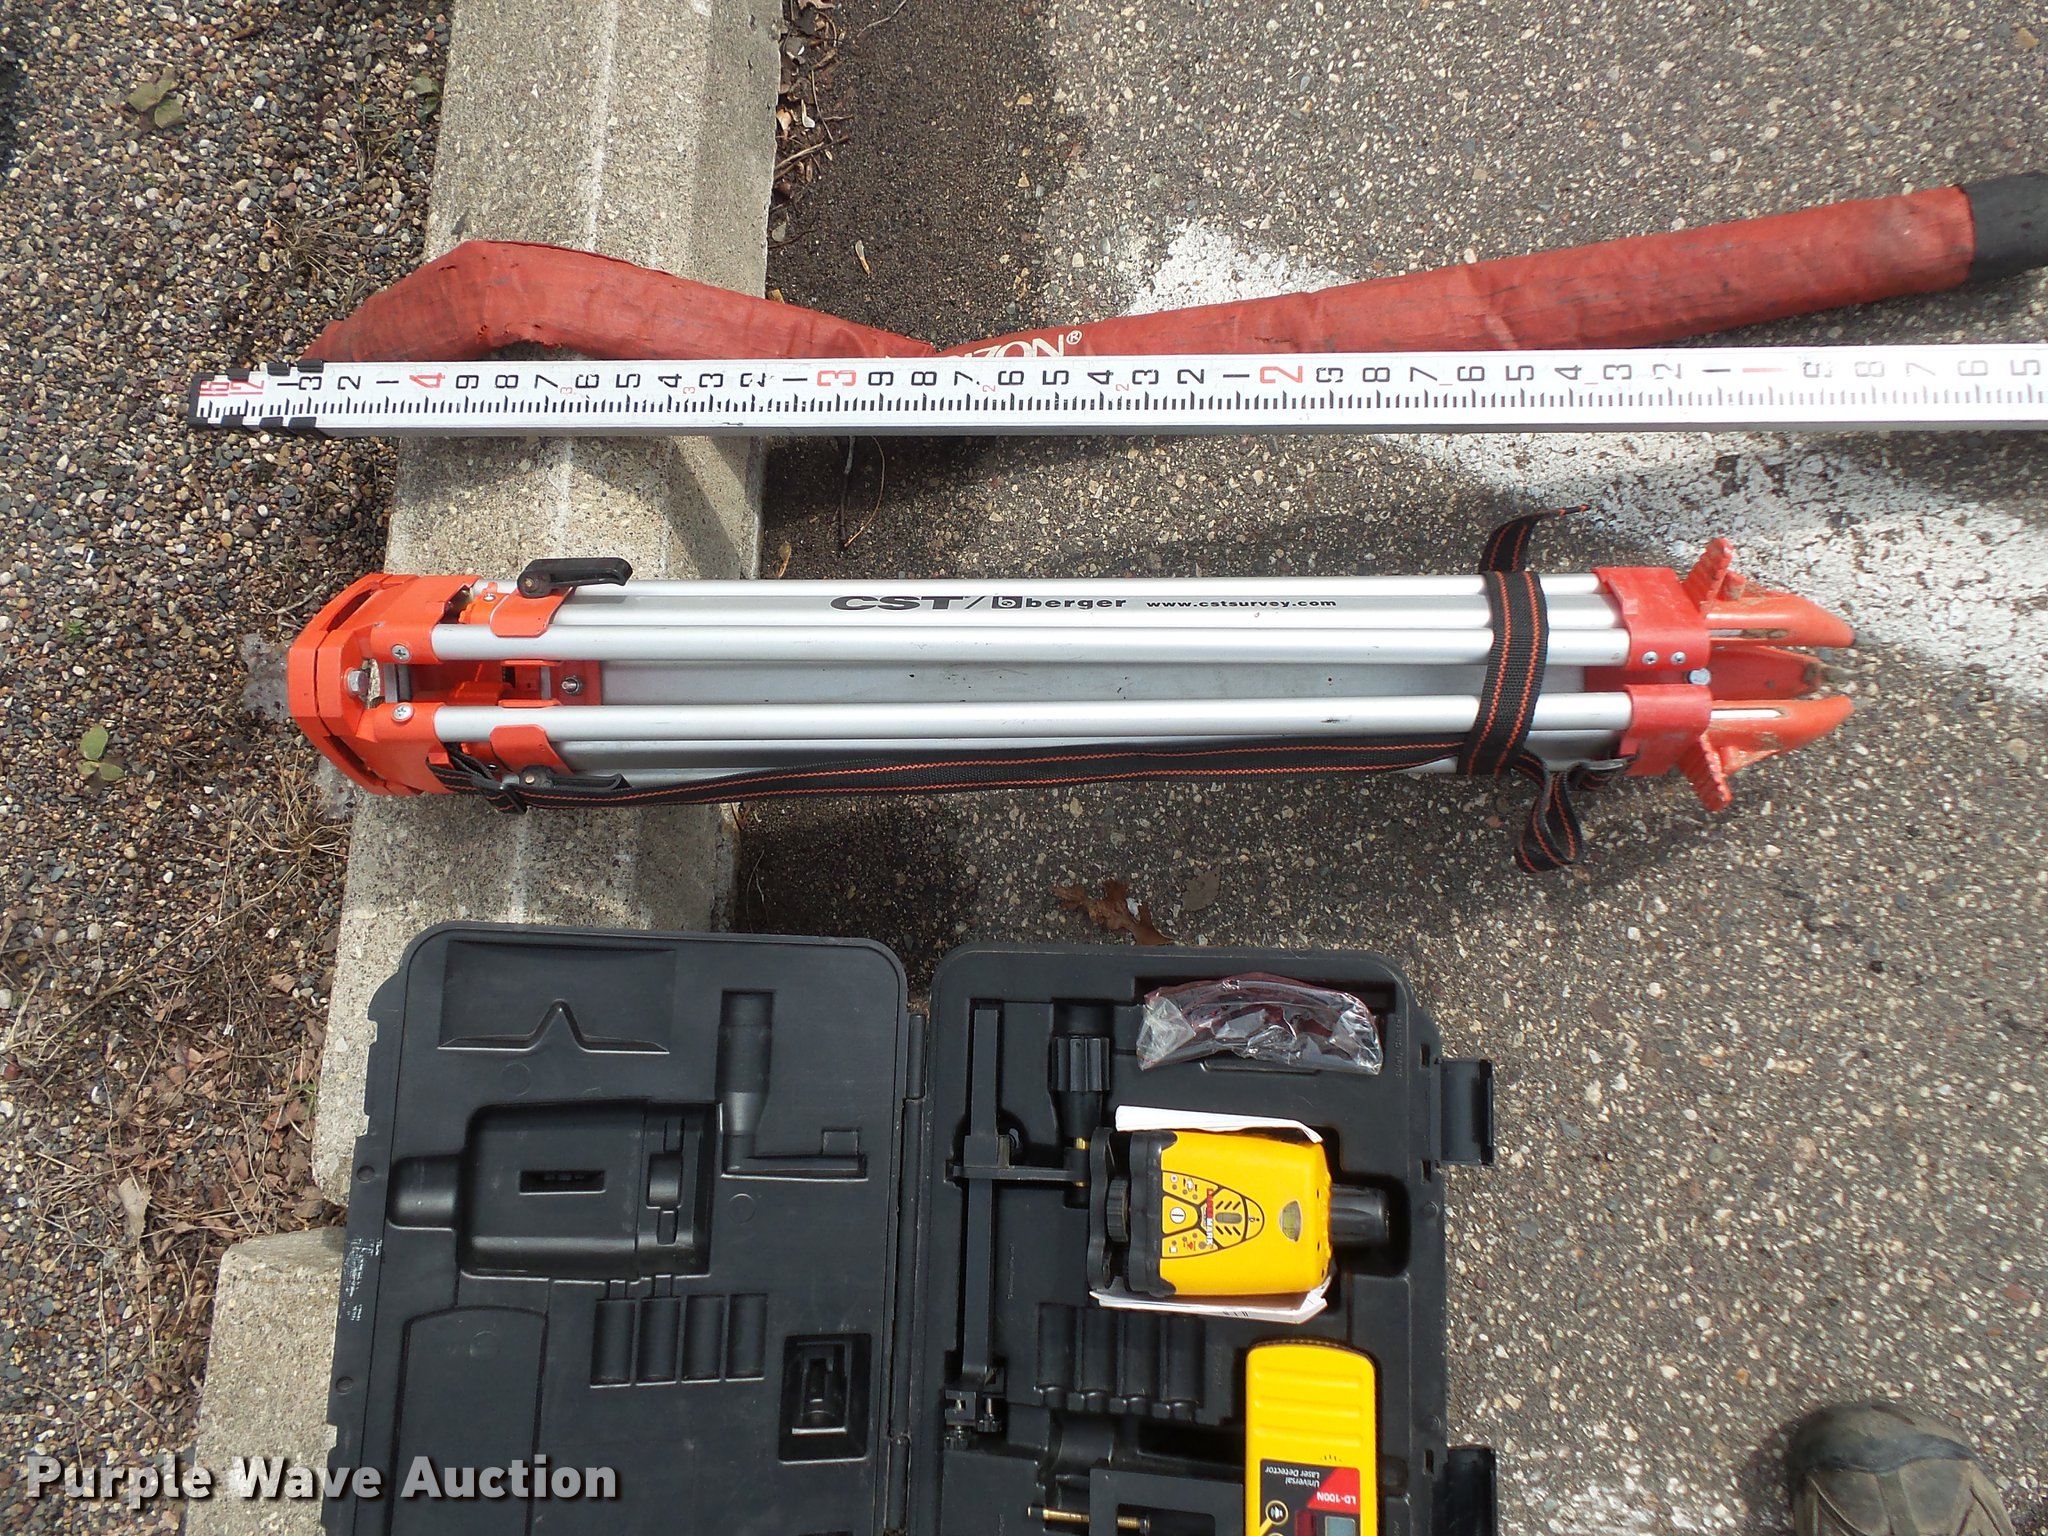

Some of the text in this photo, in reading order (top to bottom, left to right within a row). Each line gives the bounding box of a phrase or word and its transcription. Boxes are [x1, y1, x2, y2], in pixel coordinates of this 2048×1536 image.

[229, 380, 264, 394] 12
[299, 376, 322, 390] 3
[337, 376, 361, 390] 2
[409, 372, 445, 389] 4
[456, 375, 479, 389] 9
[495, 375, 518, 389] 8
[535, 375, 558, 389] 7
[575, 374, 599, 389] 6
[616, 374, 640, 389] 5
[658, 374, 683, 389] 4
[699, 373, 723, 388] 3
[817, 370, 857, 387] 3
[868, 371, 894, 386] 9
[911, 371, 937, 386] 8
[954, 371, 980, 386] 7
[998, 371, 1024, 386] 6
[1043, 370, 1069, 386] 5
[1087, 370, 1113, 385] 4
[1132, 370, 1159, 385] 3
[1177, 369, 1204, 384] 2
[1260, 366, 1303, 384] 2
[1363, 367, 1390, 382] 8
[1410, 367, 1438, 382] 7
[1457, 366, 1485, 381] 6
[1506, 366, 1534, 381] 5
[1555, 365, 1582, 380] 4
[1603, 364, 1632, 380] 3
[1855, 361, 1884, 377] 8
[1958, 360, 1988, 376] 6
[2011, 359, 2040, 376] 5
[1146, 599, 1337, 609] www.cstsurvey.com
[1264, 1466, 1320, 1478] Laser Detector
[1285, 1476, 1320, 1488] Universal
[1316, 1491, 1356, 1505] LD-100N
